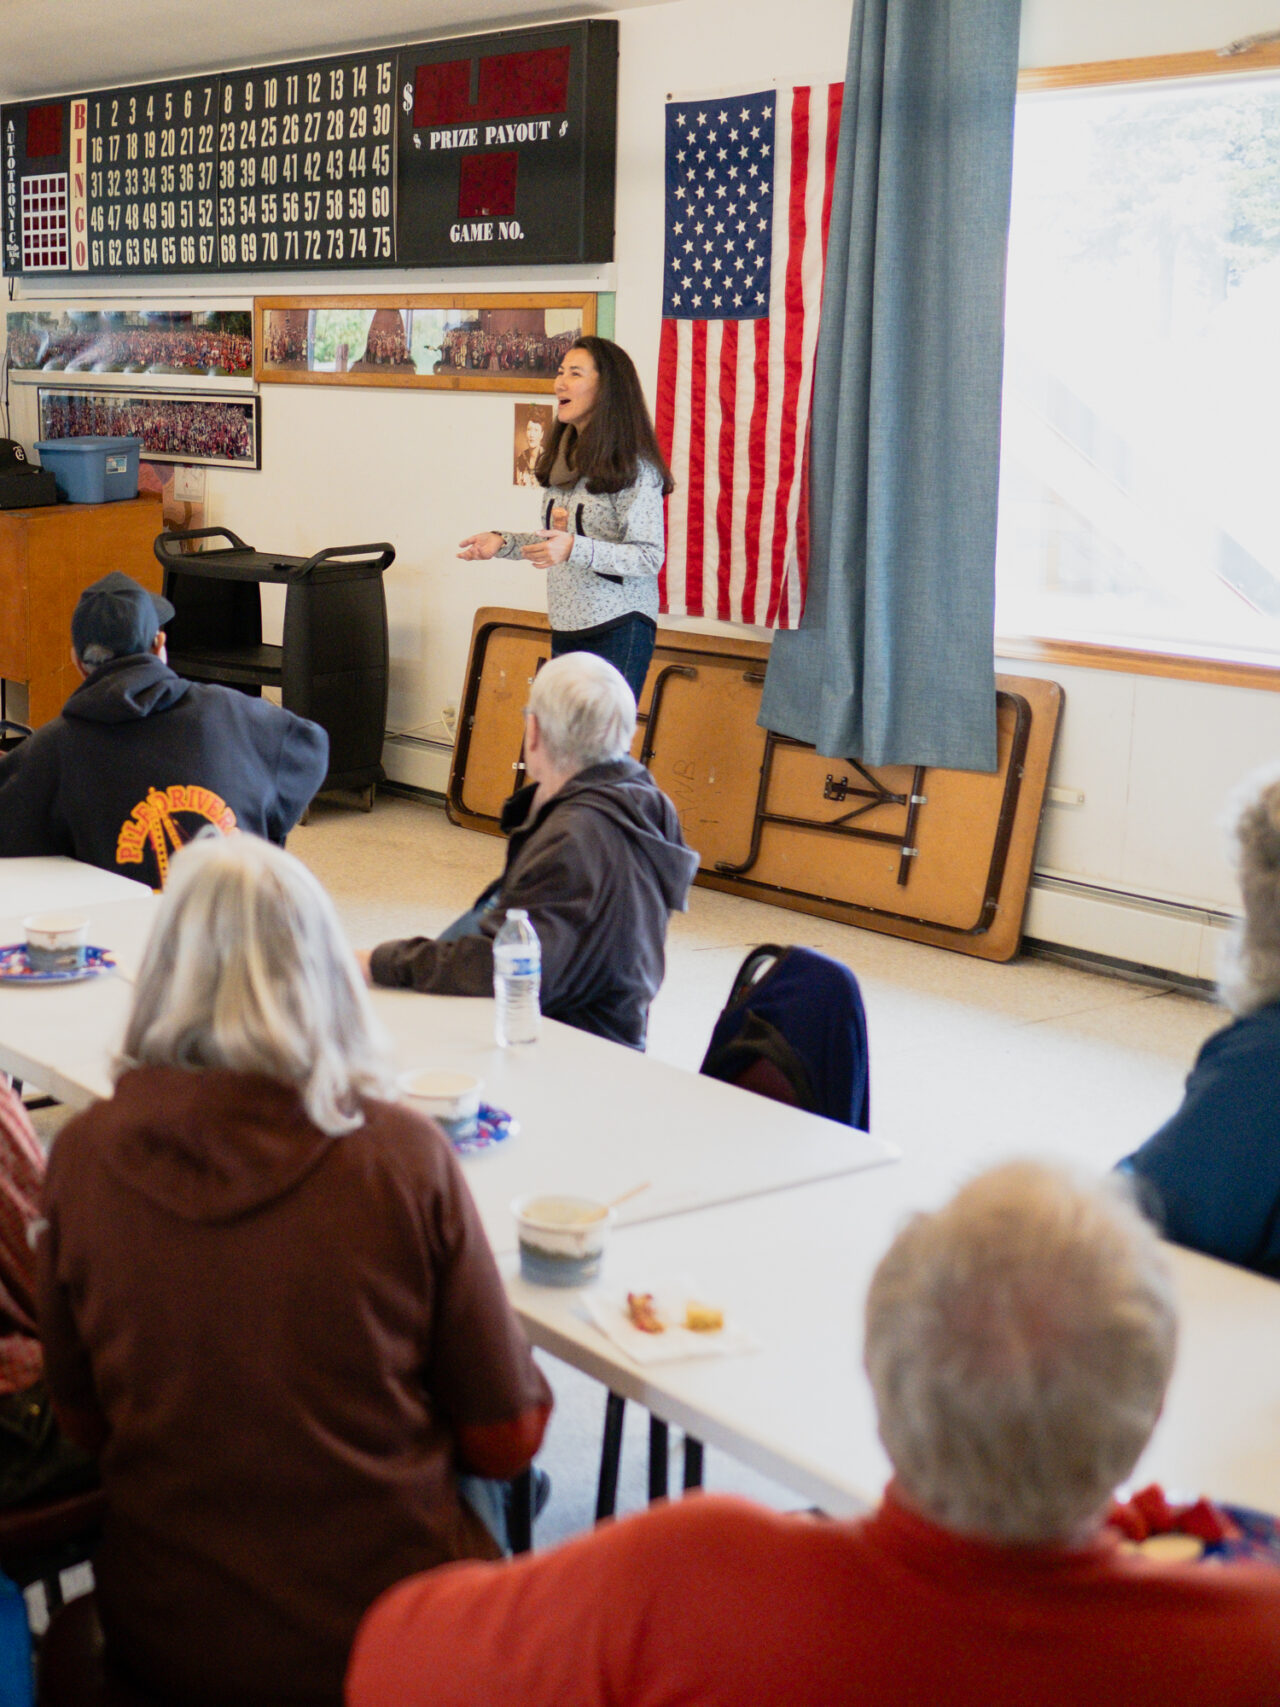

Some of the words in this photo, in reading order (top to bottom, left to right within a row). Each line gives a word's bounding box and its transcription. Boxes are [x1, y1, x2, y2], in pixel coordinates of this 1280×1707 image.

[95, 102, 101, 129] 1
[111, 99, 119, 127] 2
[128, 97, 137, 125] 3
[146, 95, 154, 123] 4
[164, 92, 173, 121] 5
[183, 89, 192, 119] 6
[203, 87, 212, 116] 7
[224, 84, 233, 114] 8
[244, 81, 254, 112] 9
[263, 77, 278, 109] 10
[285, 74, 299, 106] 11
[306, 71, 322, 104] 12
[329, 68, 344, 101] 13
[351, 65, 368, 98] 14
[376, 61, 392, 95] 15
[91, 136, 103, 164] 16
[108, 134, 121, 162] 17
[125, 132, 138, 160] 18
[143, 130, 156, 159] 19
[160, 128, 176, 158] 20
[179, 126, 194, 156] 21
[198, 124, 214, 154] 22
[219, 121, 236, 152] 23
[239, 119, 257, 150] 24
[260, 116, 277, 148] 25
[282, 113, 300, 145] 26
[303, 111, 322, 144] 27
[326, 108, 344, 141] 28
[349, 105, 368, 139] 29
[372, 102, 391, 137] 30
[430, 128, 478, 150] PRIZE
[485, 121, 551, 144] PAYOUT
[90, 171, 103, 199] 31
[107, 169, 121, 198] 32
[124, 167, 139, 196] 33
[142, 166, 157, 195] 34
[160, 164, 175, 194] 35
[179, 162, 194, 192] 36
[198, 161, 214, 191] 37
[219, 159, 235, 190] 38
[240, 157, 256, 188] 39
[260, 154, 278, 186] 40
[282, 153, 298, 183] 41
[303, 151, 321, 182] 42
[326, 148, 344, 181] 43
[348, 146, 367, 179] 44
[371, 144, 390, 177] 45
[90, 205, 105, 233] 46
[107, 204, 122, 232] 47
[124, 202, 140, 231] 48
[142, 201, 157, 230] 49
[160, 200, 176, 230] 50
[180, 199, 194, 229] 51
[198, 198, 214, 228] 52
[219, 196, 236, 227] 53
[239, 195, 257, 226] 54
[261, 193, 278, 224] 55
[282, 191, 299, 223] 56
[304, 190, 321, 222] 57
[326, 188, 344, 221] 58
[348, 187, 367, 220] 59
[371, 185, 390, 218] 60
[449, 223, 493, 242] GAME
[499, 221, 525, 240] NO.
[91, 239, 105, 267] 61
[108, 238, 123, 266] 62
[125, 237, 140, 266] 63
[142, 237, 158, 266] 64
[161, 236, 177, 265] 65
[180, 235, 196, 265] 66
[199, 234, 215, 264] 67
[220, 233, 237, 264] 68
[240, 232, 257, 263] 69
[261, 231, 279, 262] 70
[283, 230, 299, 261] 71
[303, 229, 322, 260] 72
[326, 228, 344, 260] 73
[349, 227, 367, 259] 74
[372, 225, 391, 258] 75
